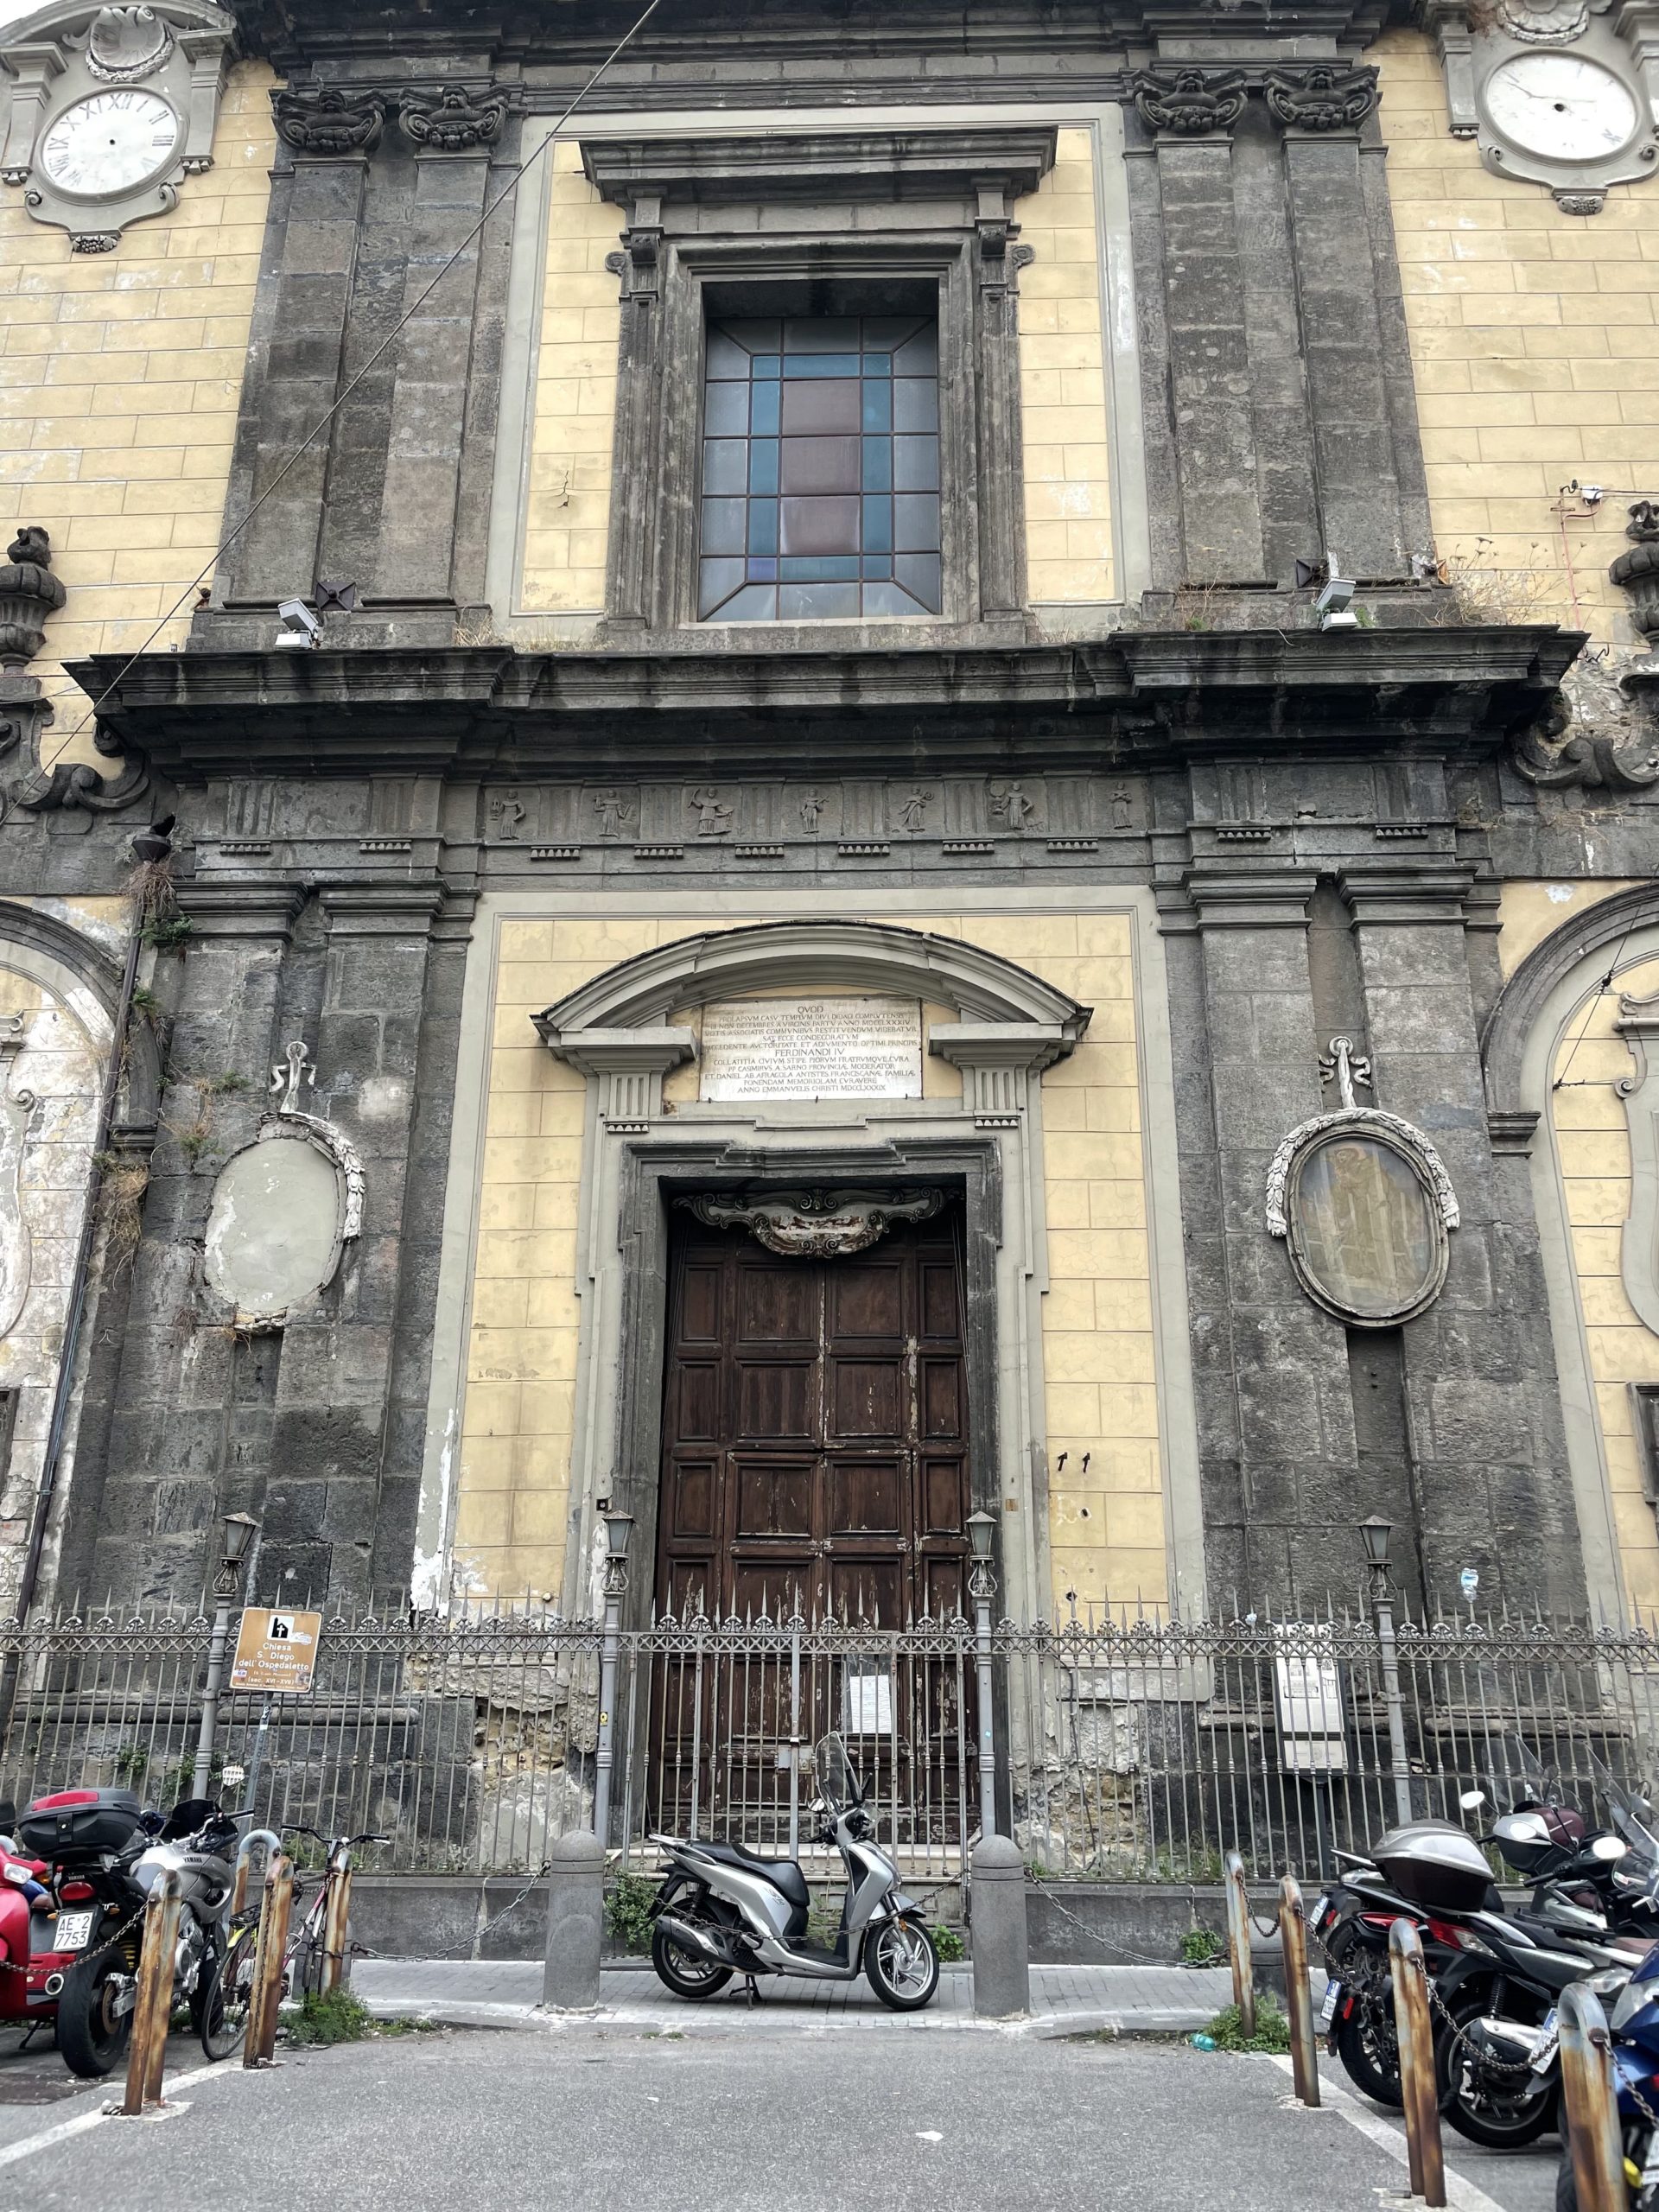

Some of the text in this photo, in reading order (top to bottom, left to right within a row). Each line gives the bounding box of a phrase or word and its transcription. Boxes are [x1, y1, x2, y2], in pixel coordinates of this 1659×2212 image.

[798, 1005, 823, 1014] QVOD
[774, 1047, 845, 1057] FERDINANDI IV
[263, 1642, 292, 1651] Chiesa
[270, 1651, 296, 1662] Diego
[238, 1658, 309, 1671] dell' Ospedaletto
[59, 1915, 90, 1932] AE 2
[54, 1930, 88, 1949] 7753
